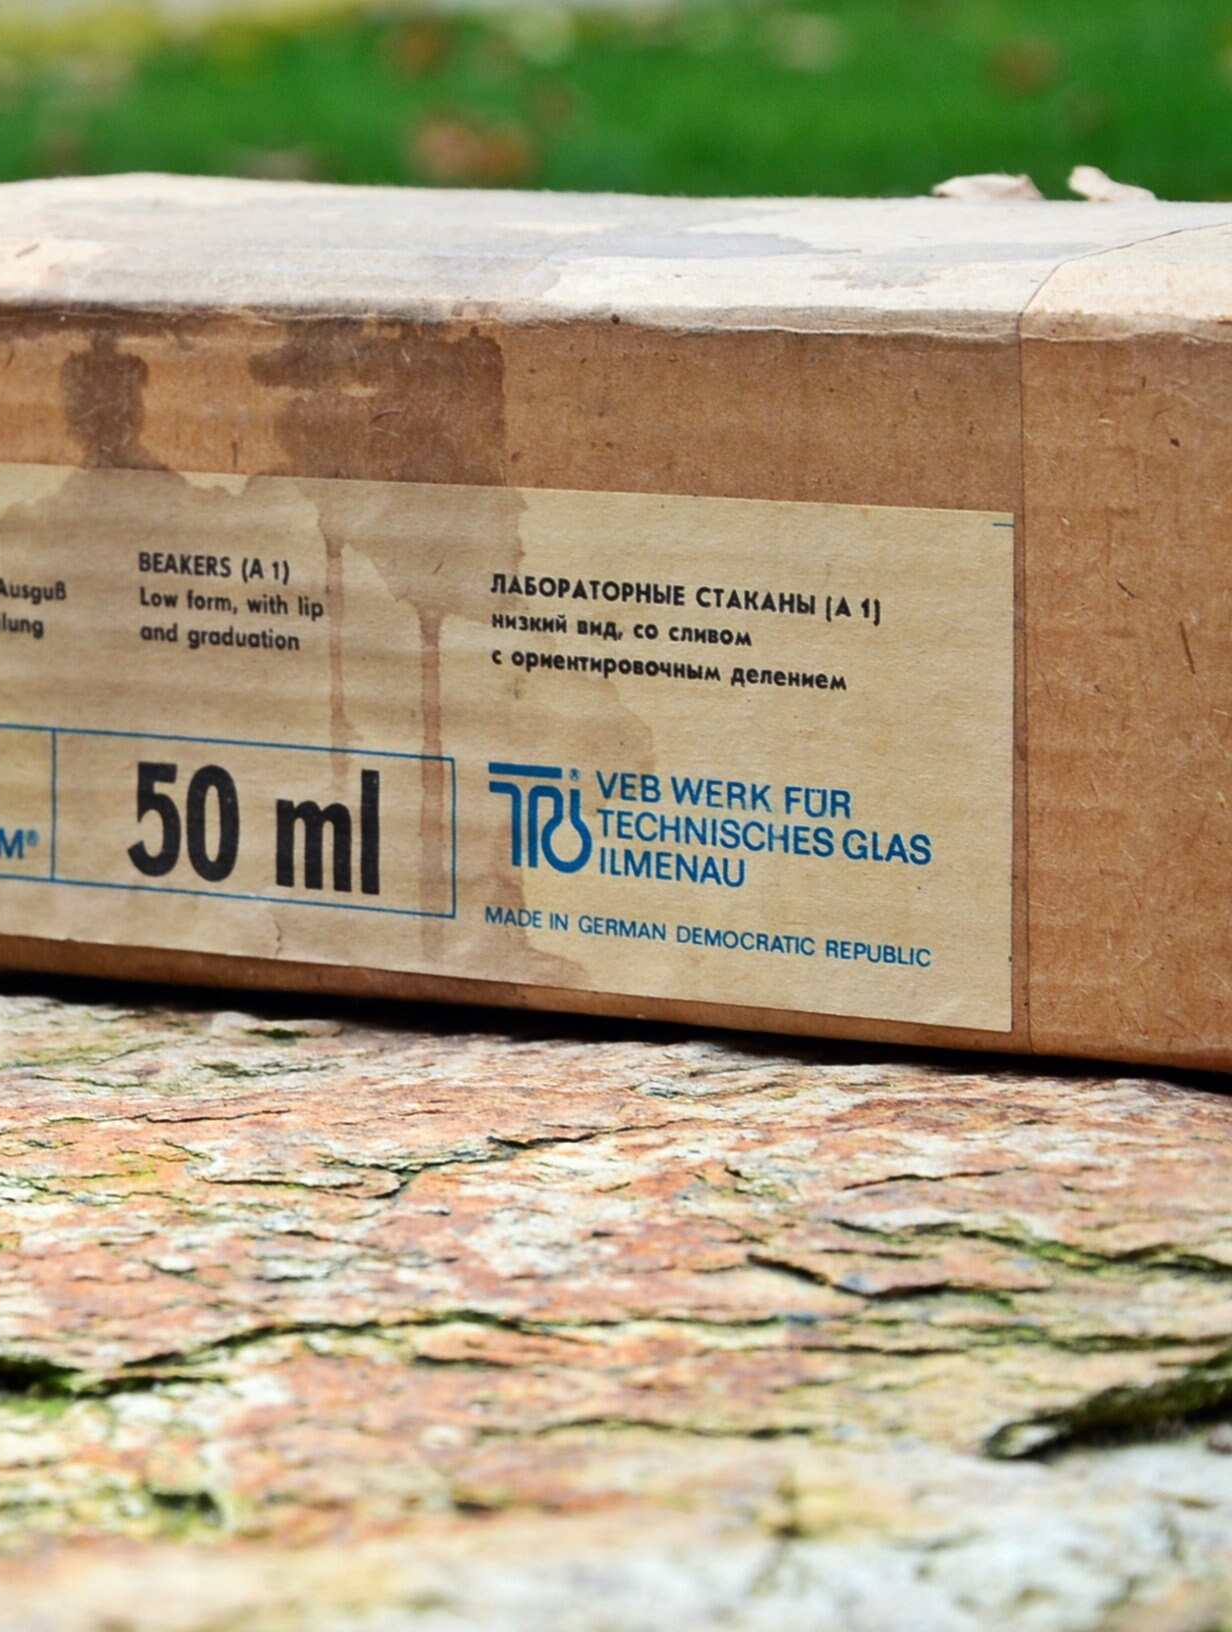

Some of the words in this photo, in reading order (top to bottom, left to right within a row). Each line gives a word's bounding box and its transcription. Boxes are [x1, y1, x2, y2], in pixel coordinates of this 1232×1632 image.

[138, 551, 232, 578] BEAKERS
[241, 557, 264, 583] (A
[272, 560, 290, 585] 1)
[139, 586, 178, 608] Low
[186, 589, 238, 614] form,
[247, 594, 289, 615] with
[298, 595, 324, 622] lip
[490, 573, 686, 607] ЛАБОРАТОРНЫЕ
[696, 586, 816, 616] СТАКАНЫ
[140, 623, 178, 643] and
[187, 625, 300, 651] graduation
[491, 612, 568, 635] низкий
[577, 619, 624, 641] вид,
[633, 624, 659, 640] со
[668, 625, 752, 647] сливом
[511, 650, 721, 683] ориентировочным
[731, 667, 848, 691] делением
[596, 770, 662, 804] VEB
[671, 776, 772, 813] WERK
[784, 786, 852, 819] FÜR
[127, 761, 240, 883] 50
[276, 769, 380, 895] ml
[597, 808, 835, 858] TECHNISCHES
[842, 829, 932, 865] GLAS
[599, 848, 746, 888] ILMENAU
[485, 906, 542, 930] MADE
[549, 912, 568, 931] IN
[578, 915, 666, 942] GERMAN
[676, 925, 816, 957] DEMOCRATIC
[825, 939, 932, 968] REPUBLIC
